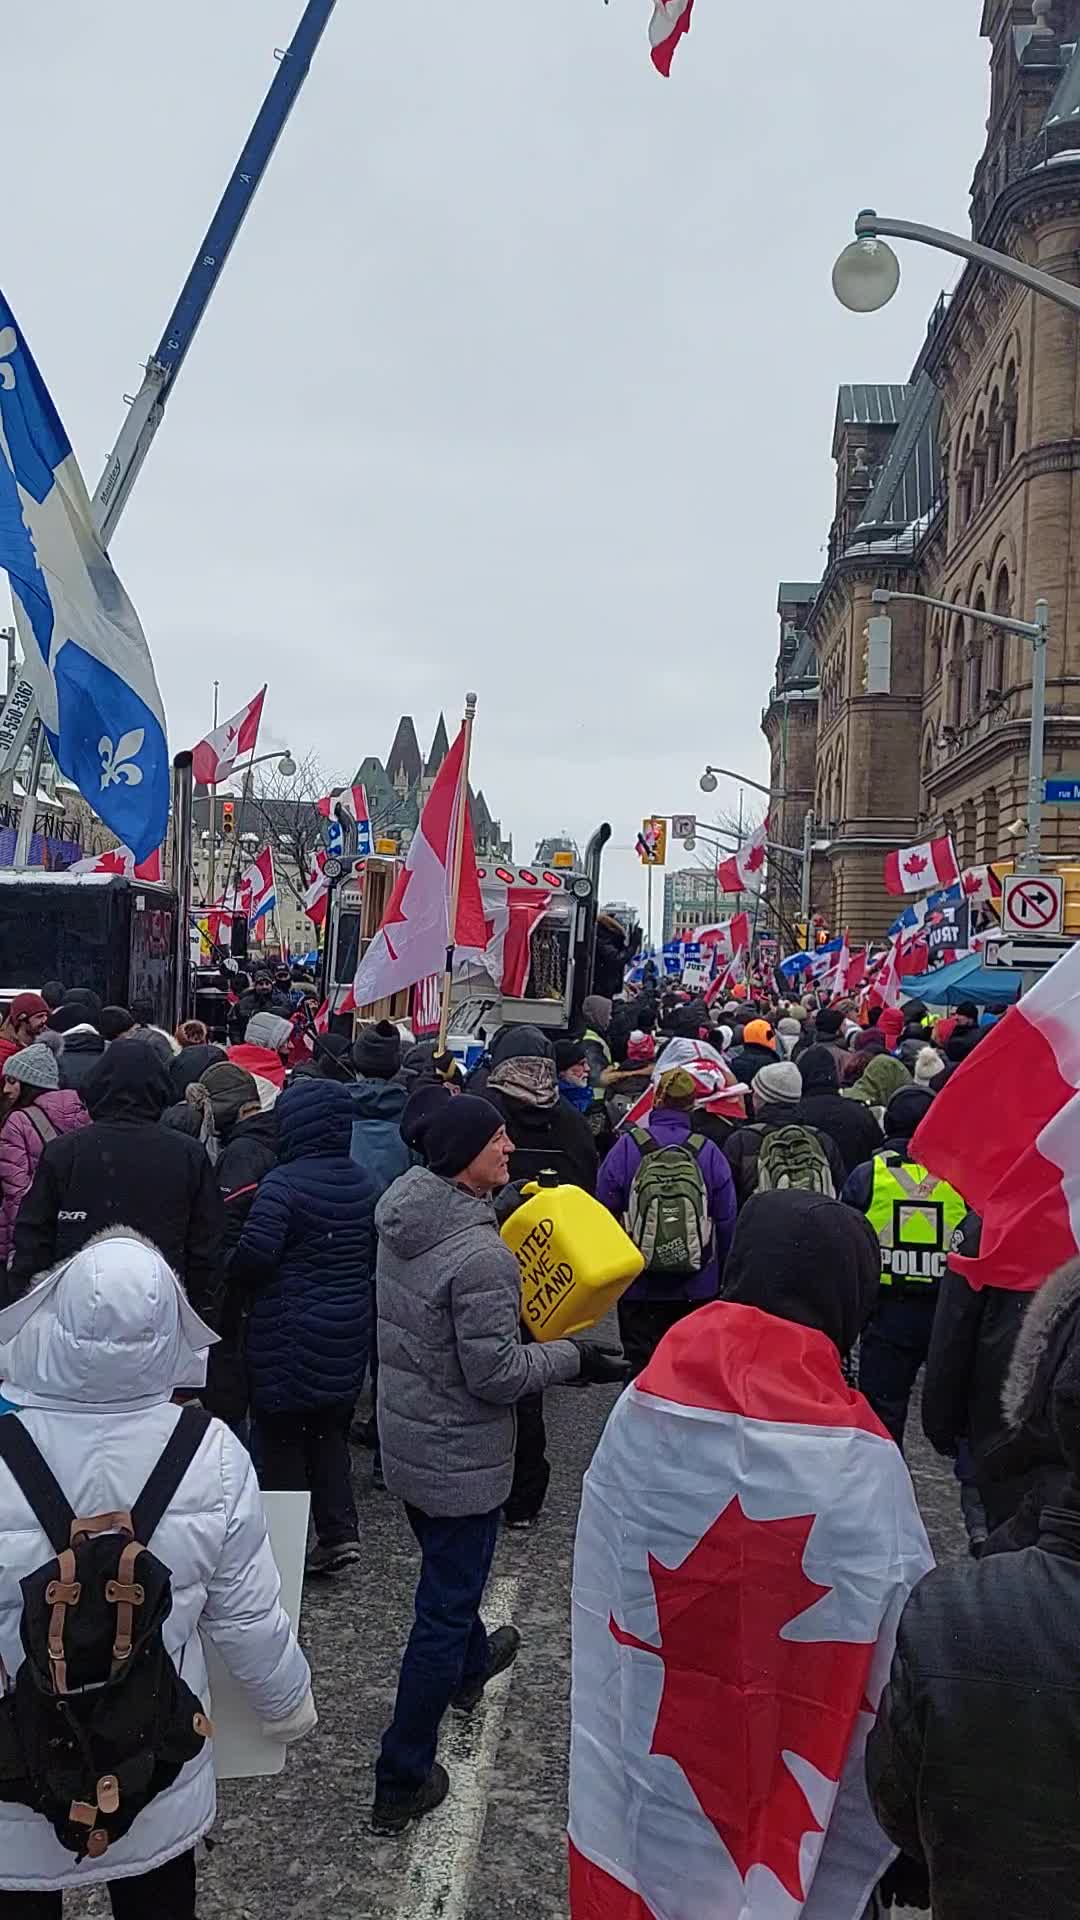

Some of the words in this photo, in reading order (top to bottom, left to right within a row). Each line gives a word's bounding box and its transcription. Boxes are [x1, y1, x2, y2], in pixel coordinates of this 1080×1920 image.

[515, 1219, 554, 1274] NITED
[880, 1248, 948, 1278] POLIC
[526, 1262, 574, 1322] STAND
